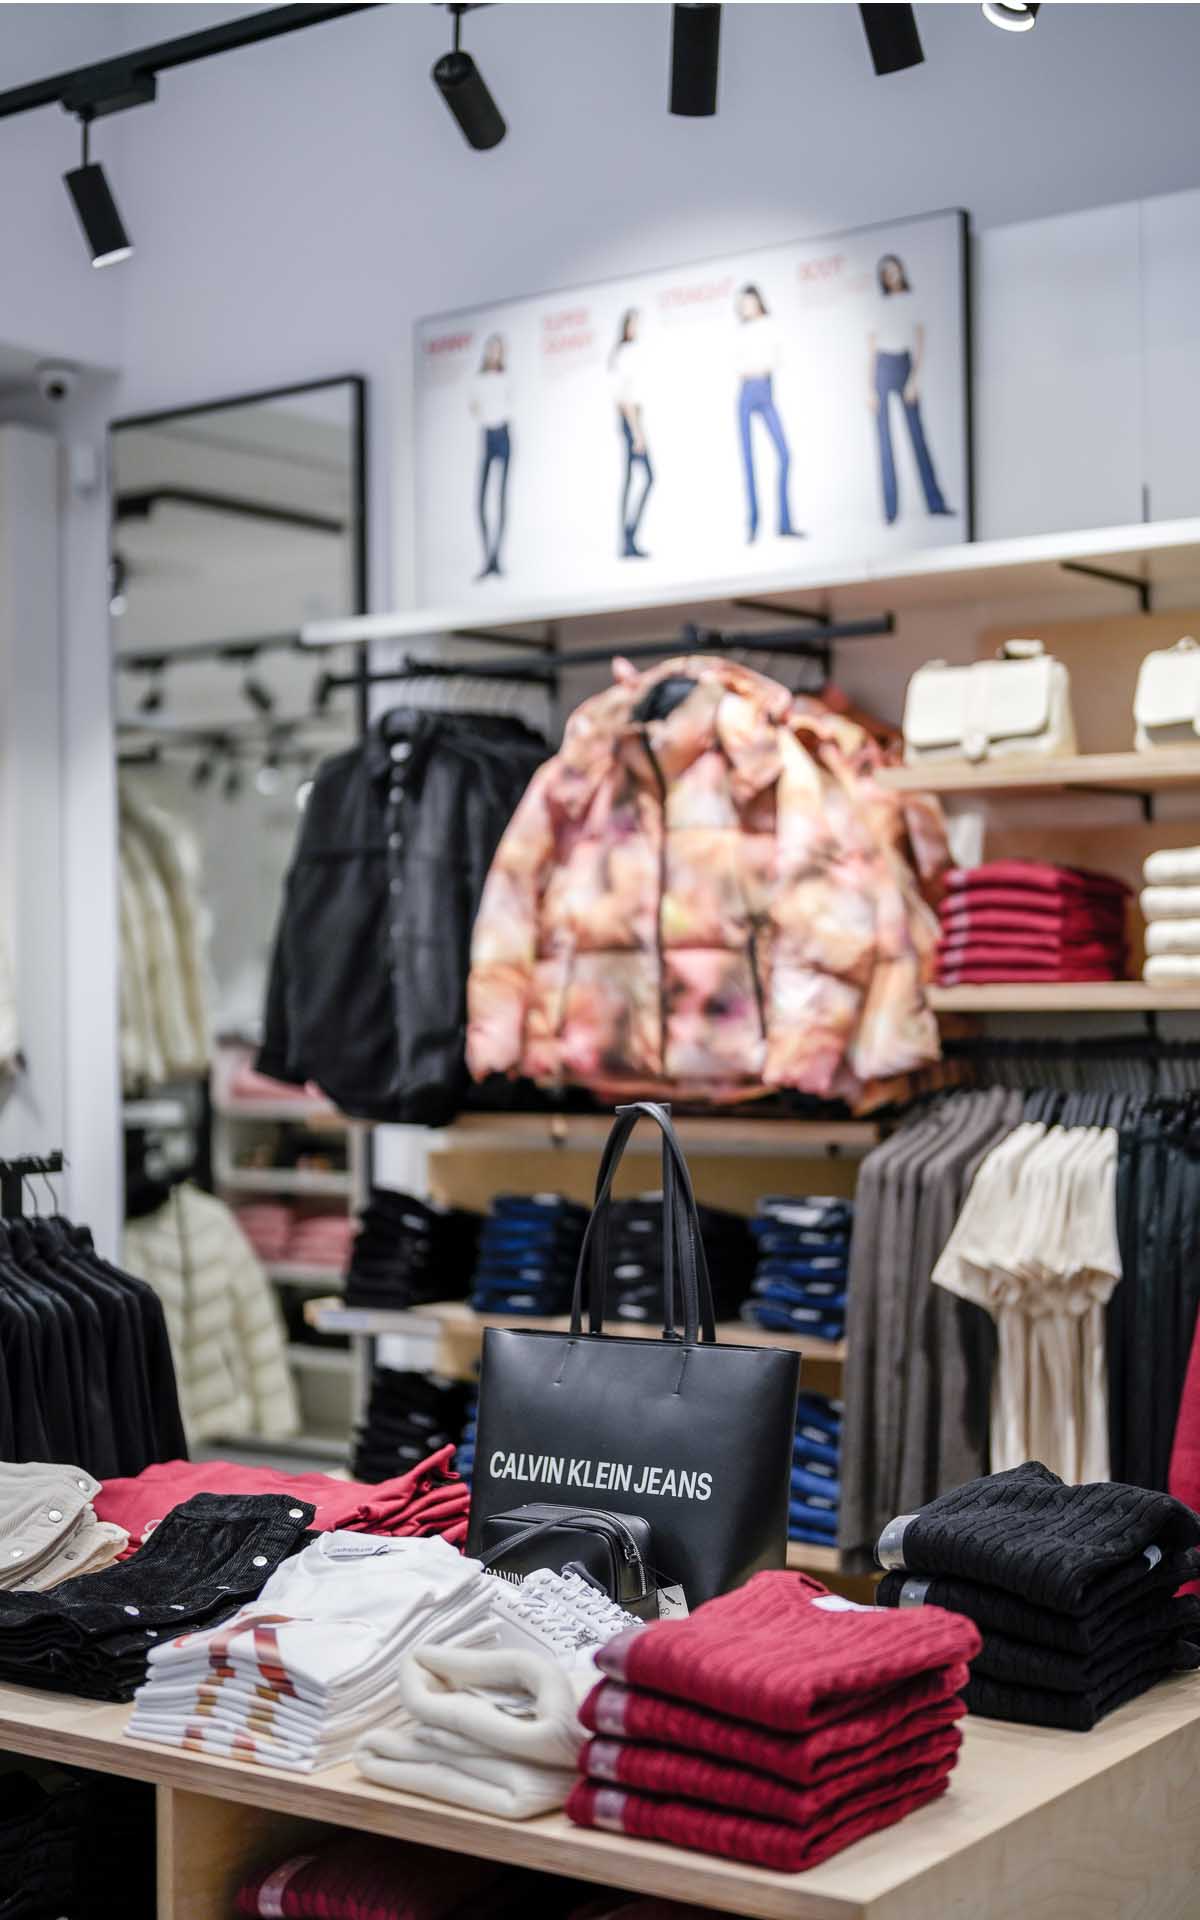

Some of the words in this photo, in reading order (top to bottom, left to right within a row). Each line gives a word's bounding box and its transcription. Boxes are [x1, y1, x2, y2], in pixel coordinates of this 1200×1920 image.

[490, 1451, 564, 1484] CALVIN
[567, 1459, 631, 1492] KLEIN
[634, 1466, 713, 1501] JEANS
